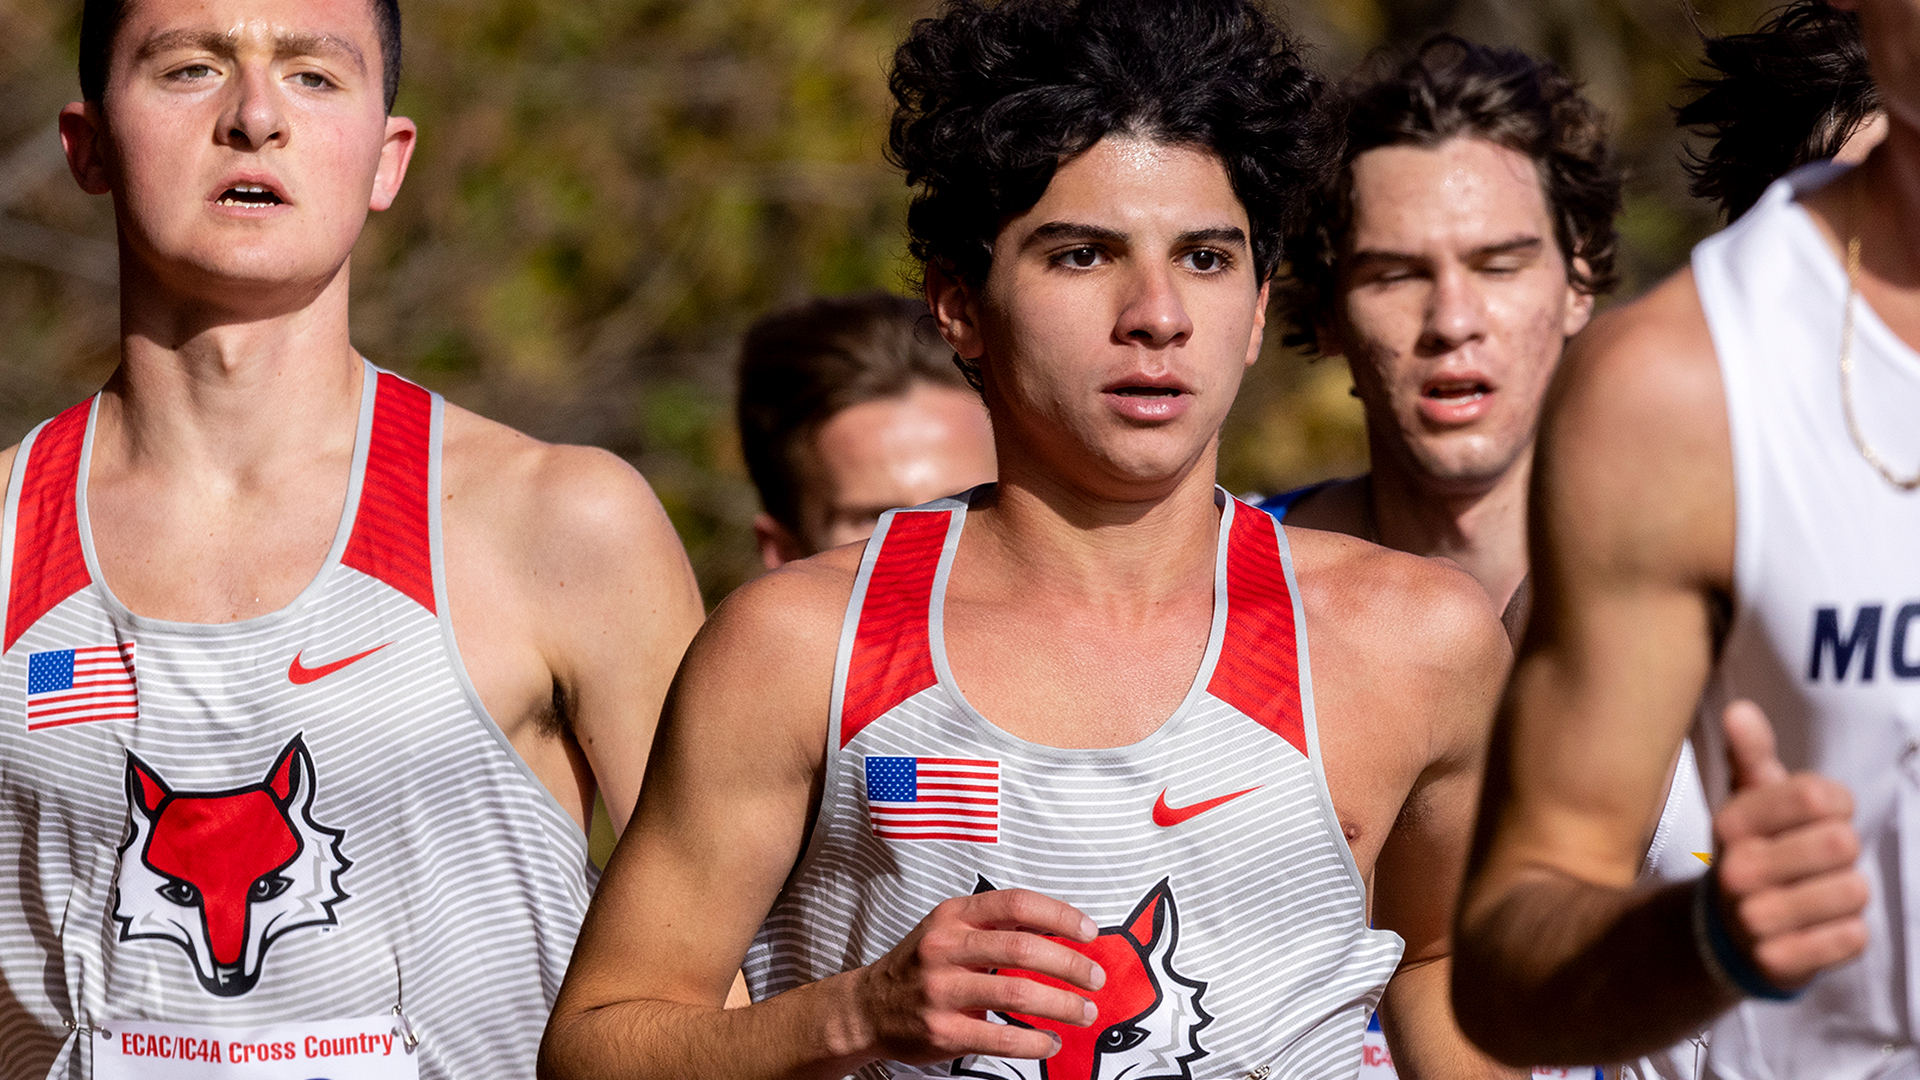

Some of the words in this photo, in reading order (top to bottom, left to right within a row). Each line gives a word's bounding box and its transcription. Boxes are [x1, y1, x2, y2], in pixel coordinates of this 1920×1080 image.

[121, 1032, 222, 1064] ECAC/IC4A
[228, 1041, 297, 1064] Cross
[304, 1032, 394, 1059] Country
